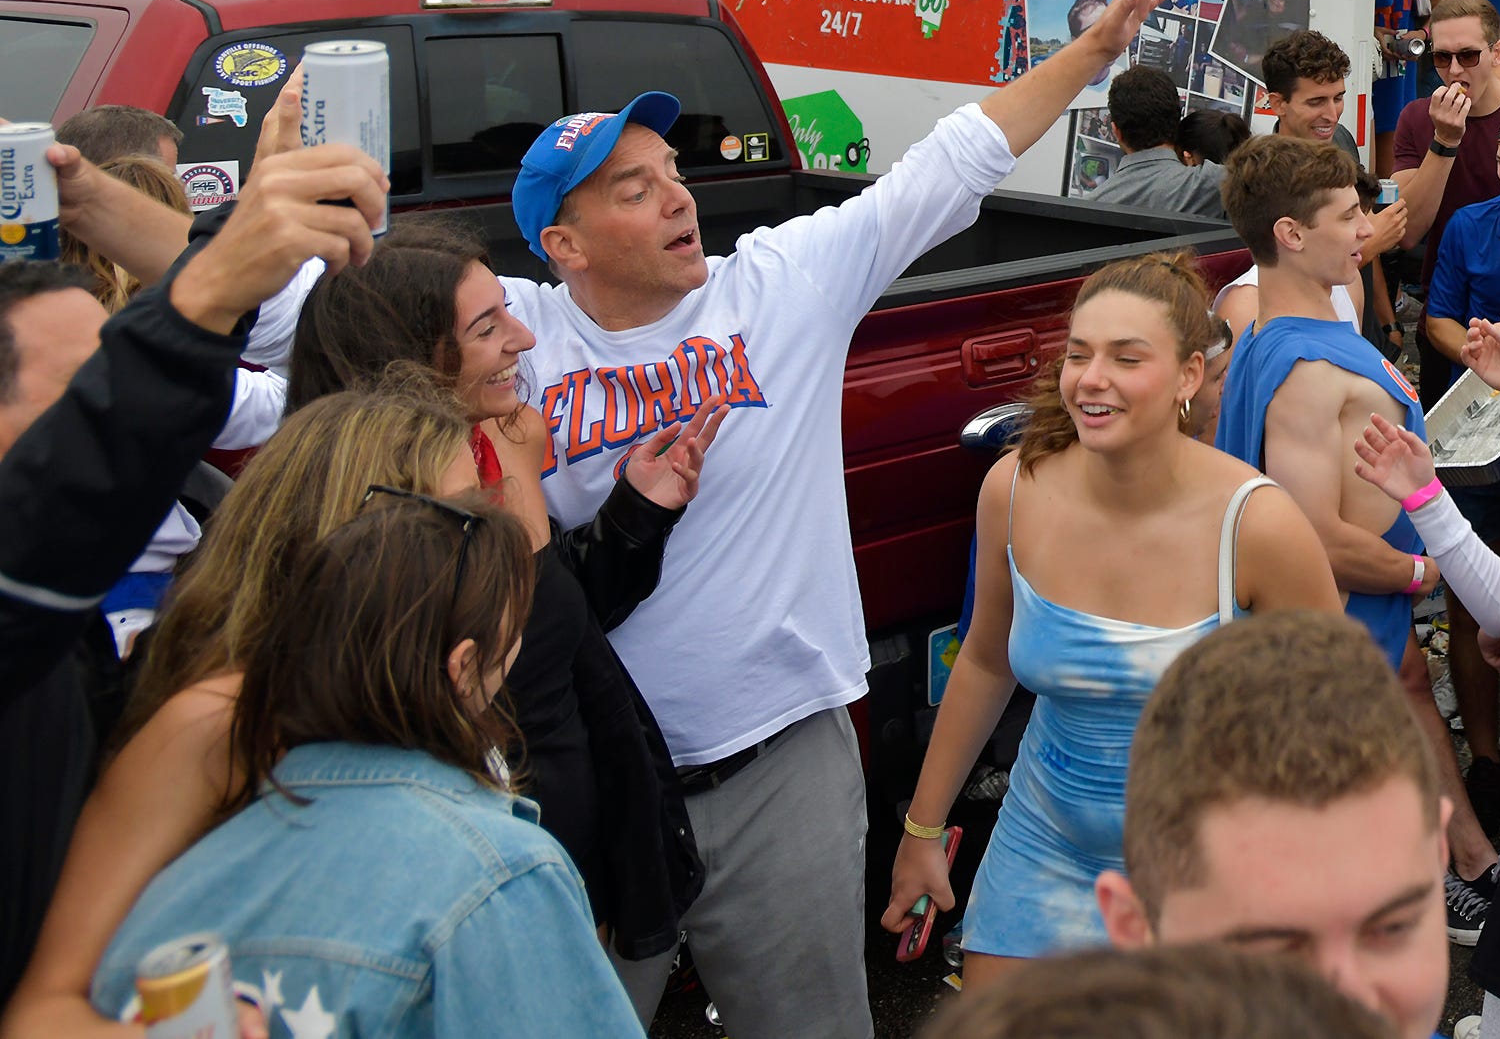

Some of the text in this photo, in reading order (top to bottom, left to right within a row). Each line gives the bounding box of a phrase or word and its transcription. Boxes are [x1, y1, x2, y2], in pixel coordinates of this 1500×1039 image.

[820, 9, 863, 38] 24/7
[0, 147, 22, 220] Corona
[19, 164, 35, 200] Extra
[192, 181, 217, 191] F45
[540, 333, 768, 481] FLORIDA
